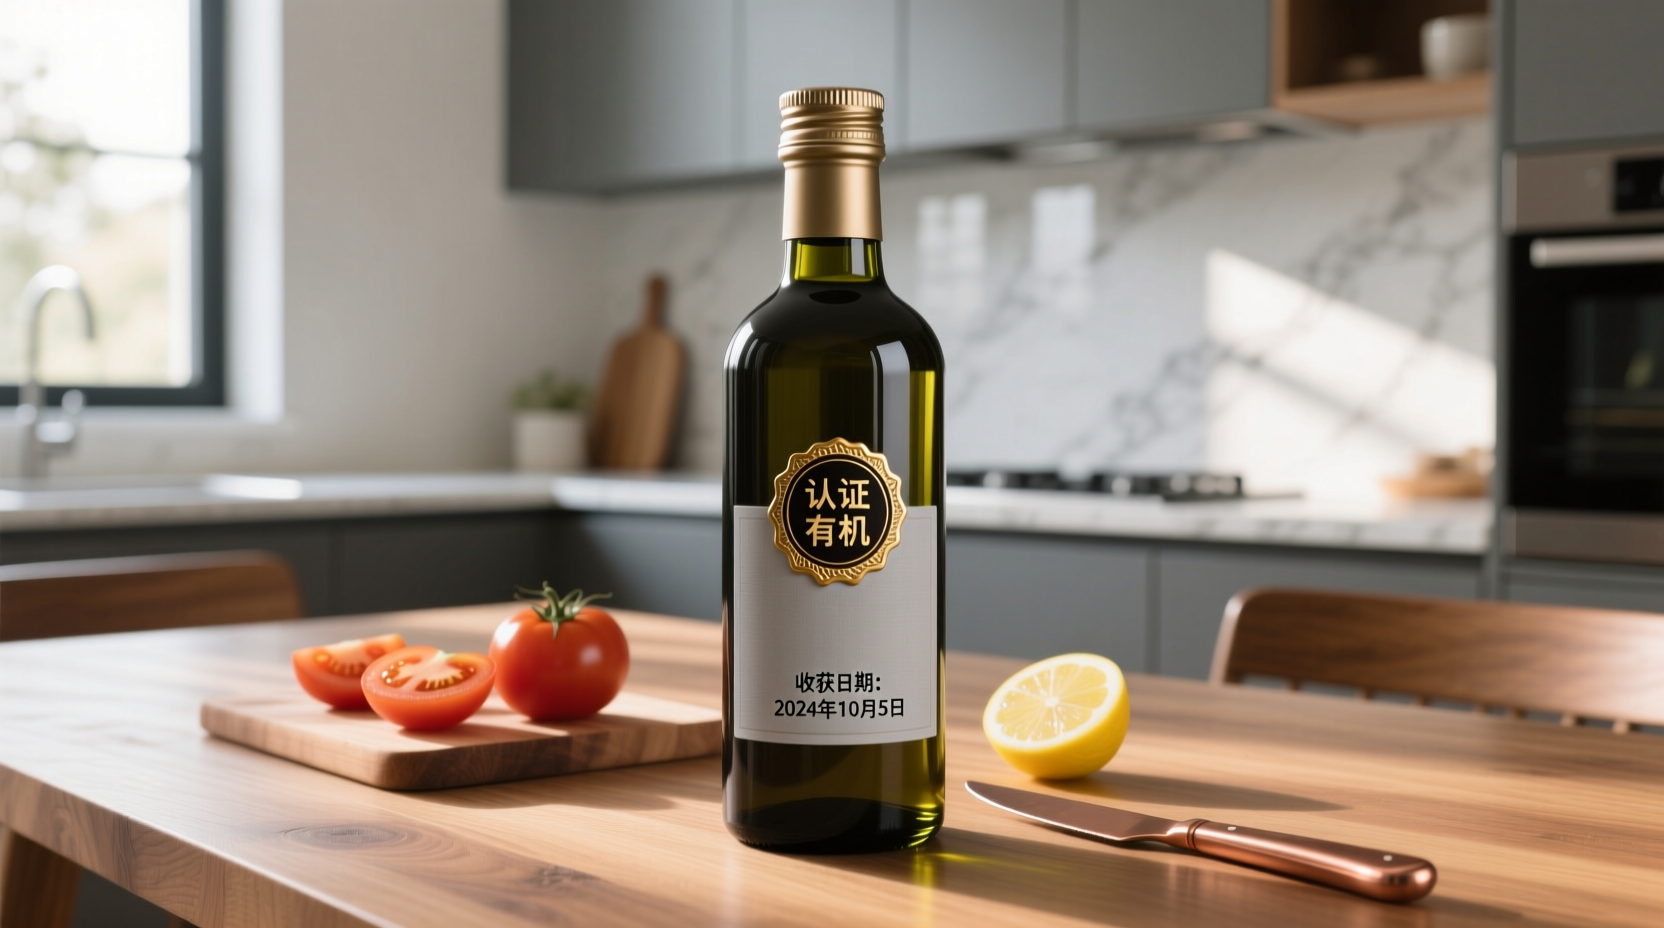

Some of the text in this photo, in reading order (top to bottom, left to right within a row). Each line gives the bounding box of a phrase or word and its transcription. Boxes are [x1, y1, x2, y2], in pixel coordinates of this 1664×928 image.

[805, 478, 870, 510] 认证
[805, 514, 871, 547] 有机
[795, 671, 881, 693] 收获日期：
[774, 698, 904, 719] 2024年10月5日
